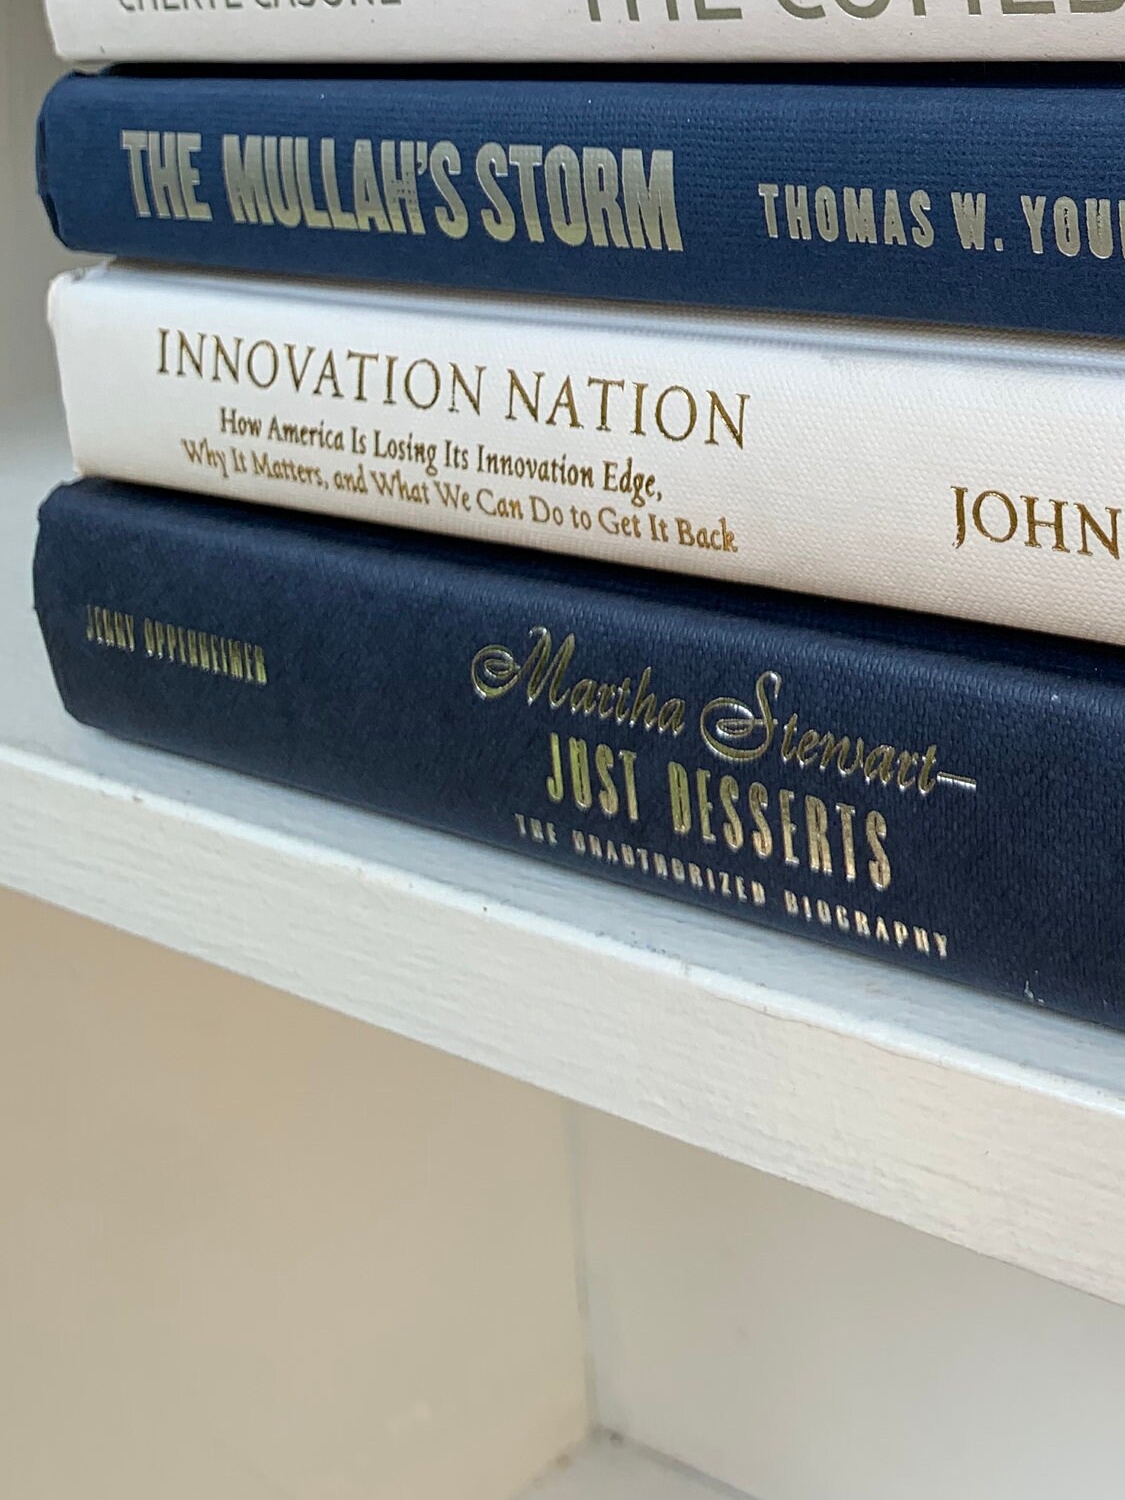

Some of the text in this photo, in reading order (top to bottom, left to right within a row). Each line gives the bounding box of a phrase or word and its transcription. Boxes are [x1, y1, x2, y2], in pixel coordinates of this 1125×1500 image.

[121, 129, 685, 252] THE MULLAH'S STORM
[757, 182, 935, 249] THOMAS
[950, 191, 1005, 252] W.
[157, 327, 751, 450] INNOVATION NATION
[180, 436, 740, 554] Why It Matters, and What We Can Do to Get It Back
[219, 406, 663, 509] How America Is Losing Its Innovation Edge,
[950, 485, 1122, 560] JOHN
[469, 625, 686, 737] Martha
[545, 731, 892, 892] JUST DESSERTS
[513, 811, 950, 960] THE UNAUTHORIZED BIOGRAPHY
